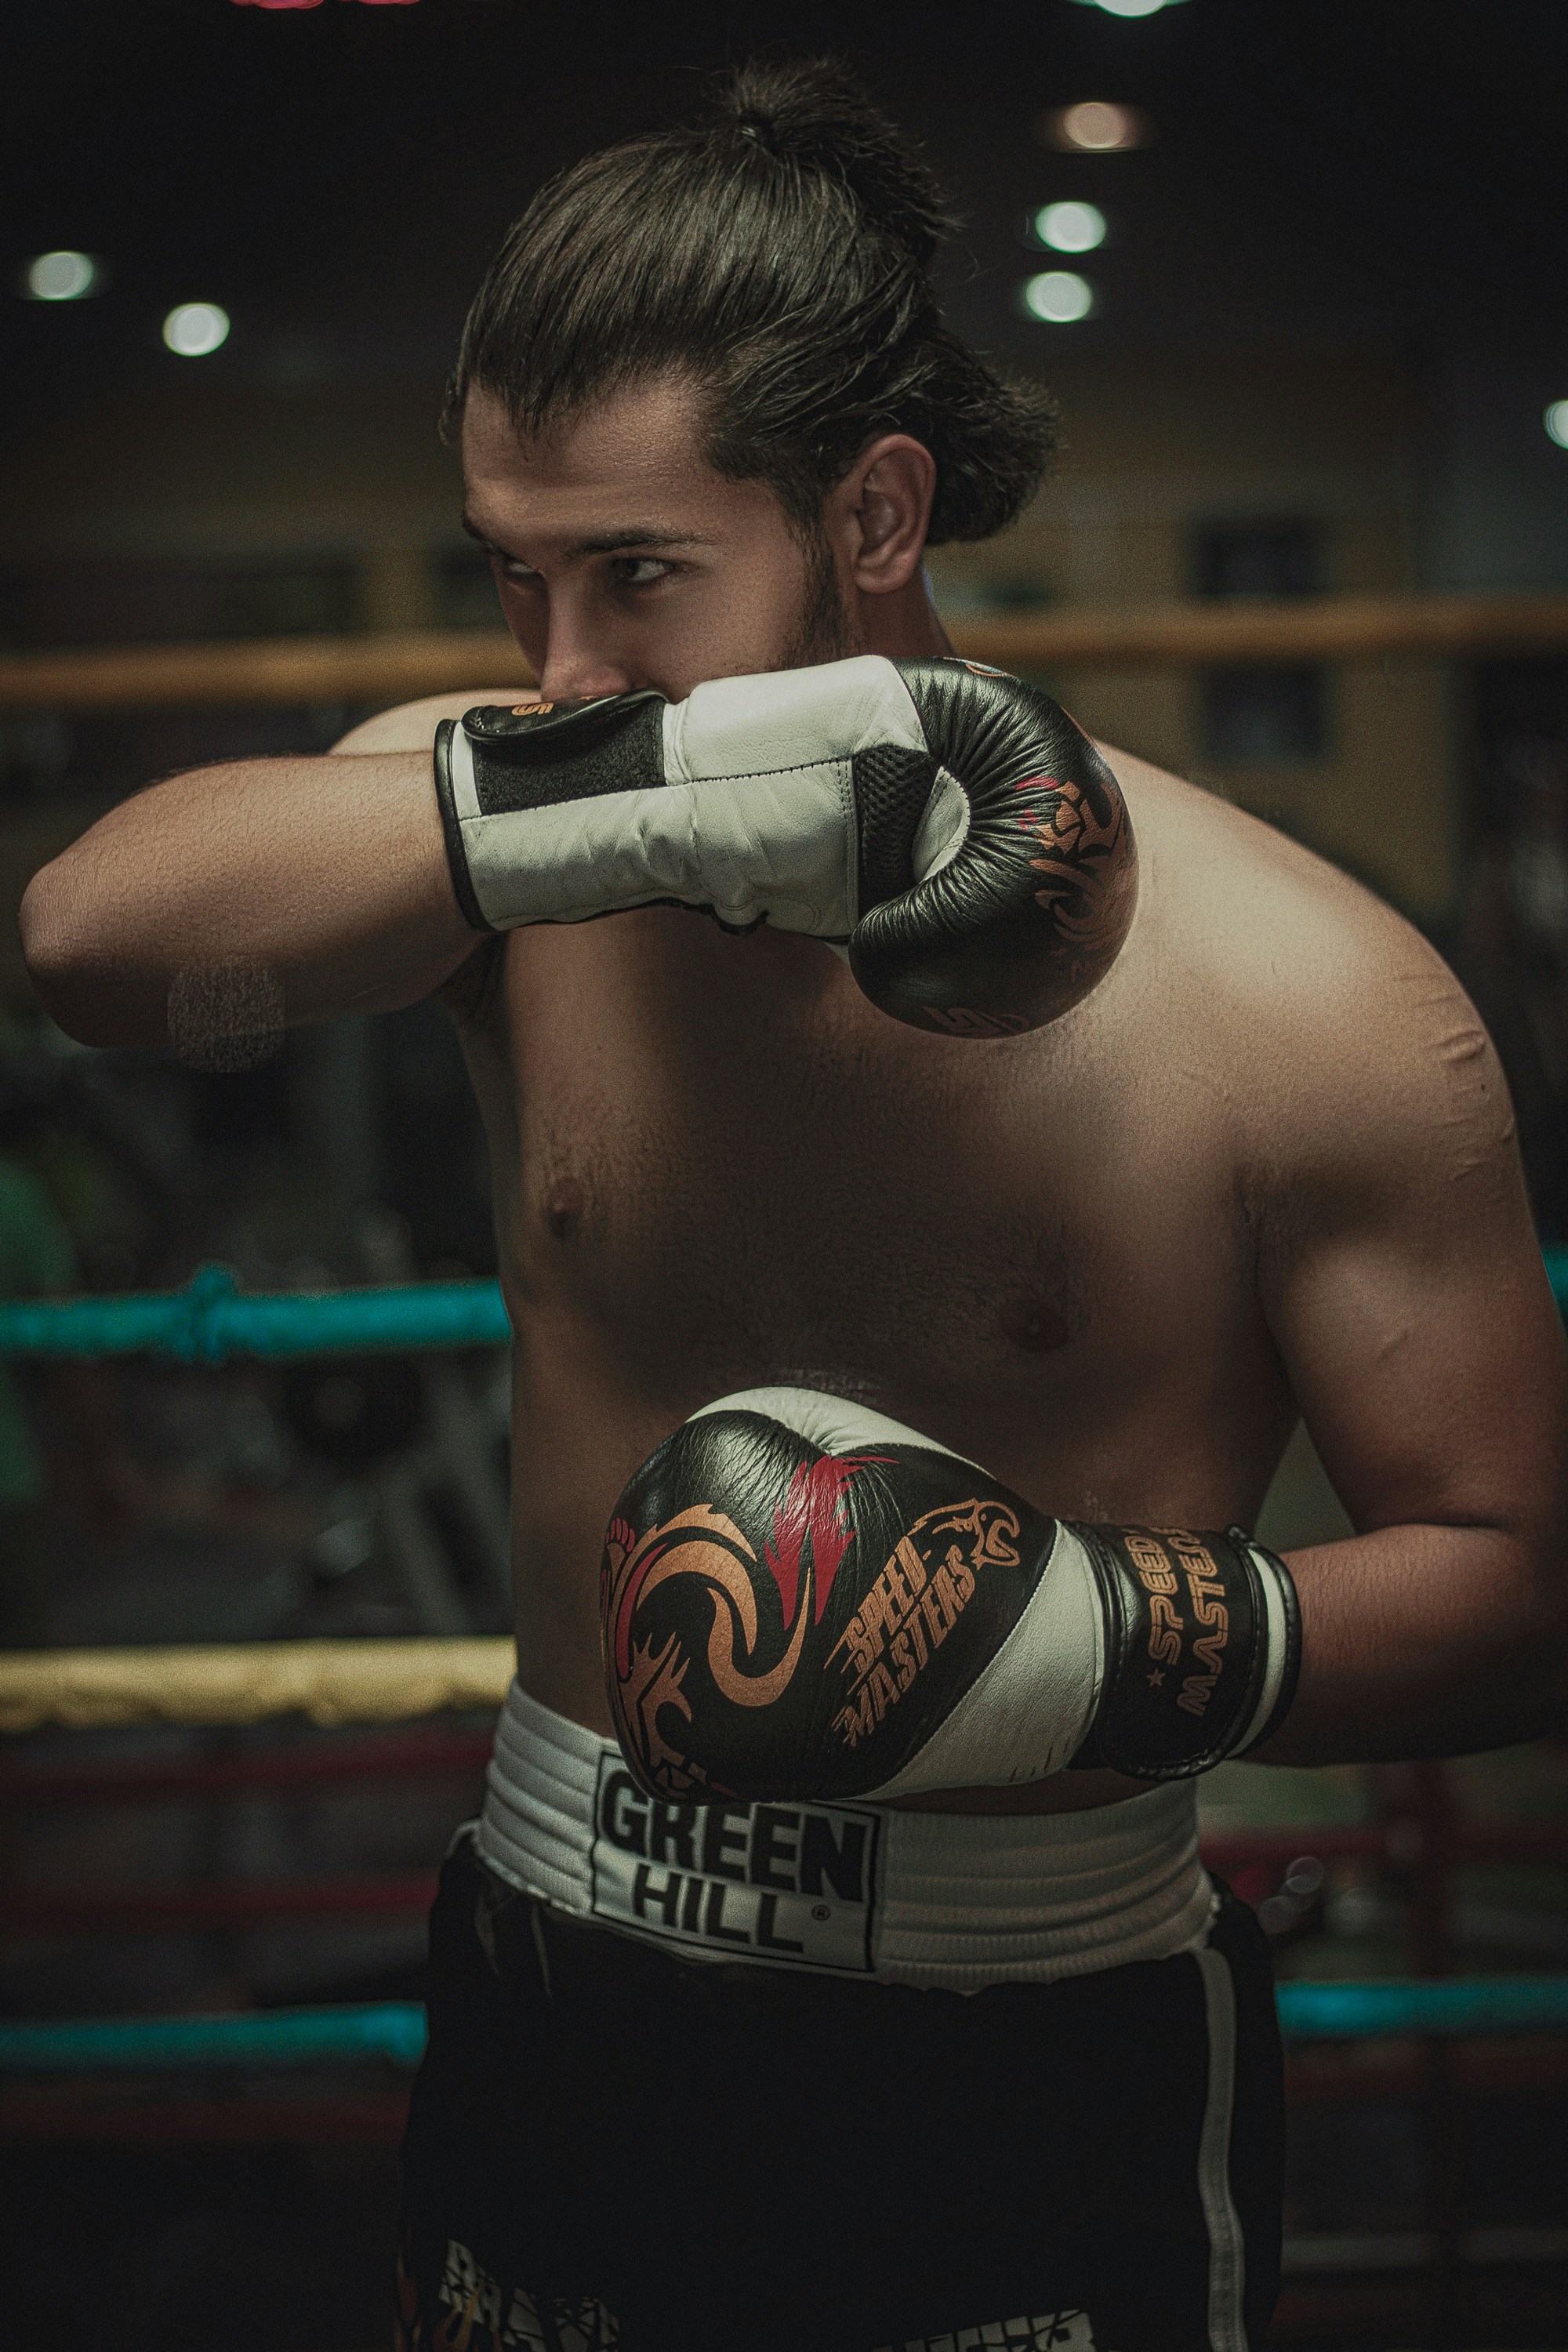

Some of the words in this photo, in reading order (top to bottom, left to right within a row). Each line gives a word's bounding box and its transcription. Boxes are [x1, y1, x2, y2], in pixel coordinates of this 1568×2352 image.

[824, 1535, 927, 1675] SPEED
[831, 1544, 975, 1747] MASTERS
[1123, 1535, 1184, 1666] SPEED
[602, 1769, 867, 1903] GREEN
[633, 1862, 804, 1954] HILL
